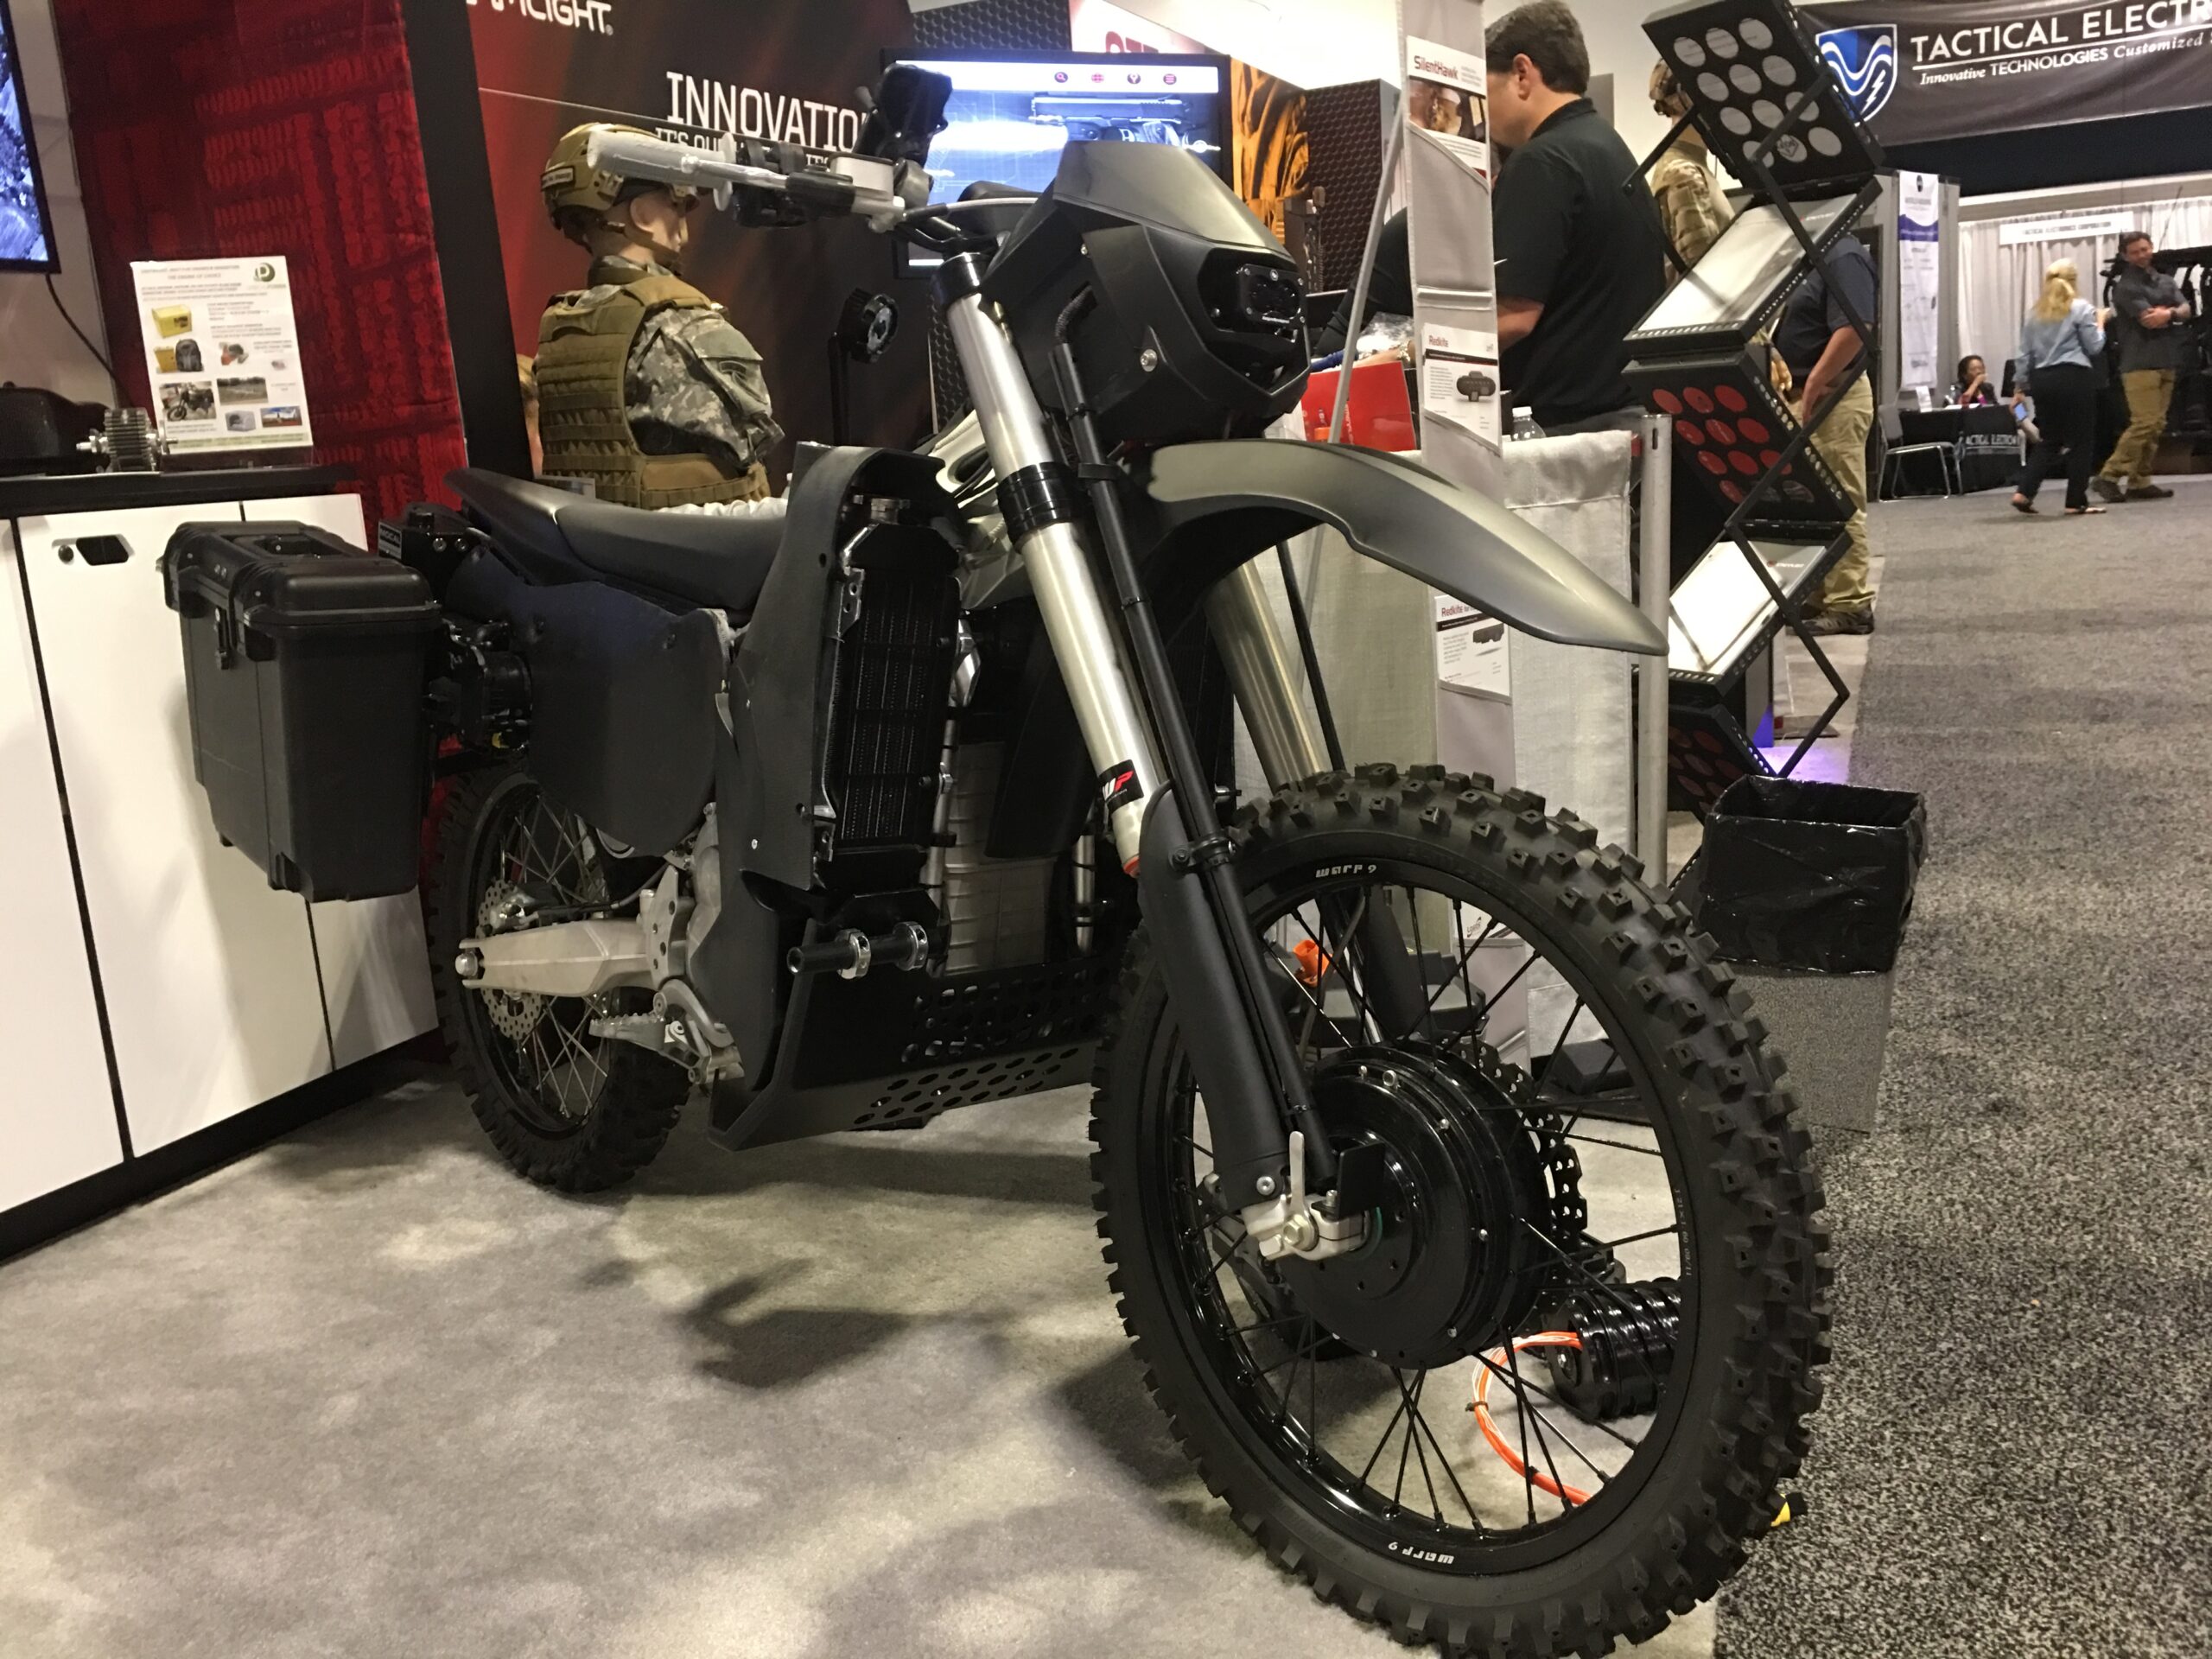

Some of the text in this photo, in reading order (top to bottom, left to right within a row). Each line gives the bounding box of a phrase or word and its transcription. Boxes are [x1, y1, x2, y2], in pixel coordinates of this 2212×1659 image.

[1910, 0, 2212, 62] TACTICAL ELECTR
[1414, 54, 1459, 80] SilentHawk
[1920, 32, 2204, 85] Innovative TECHNOLOGIES Customized
[666, 71, 867, 154] INNOVATIO
[1368, 865, 1377, 874] 9
